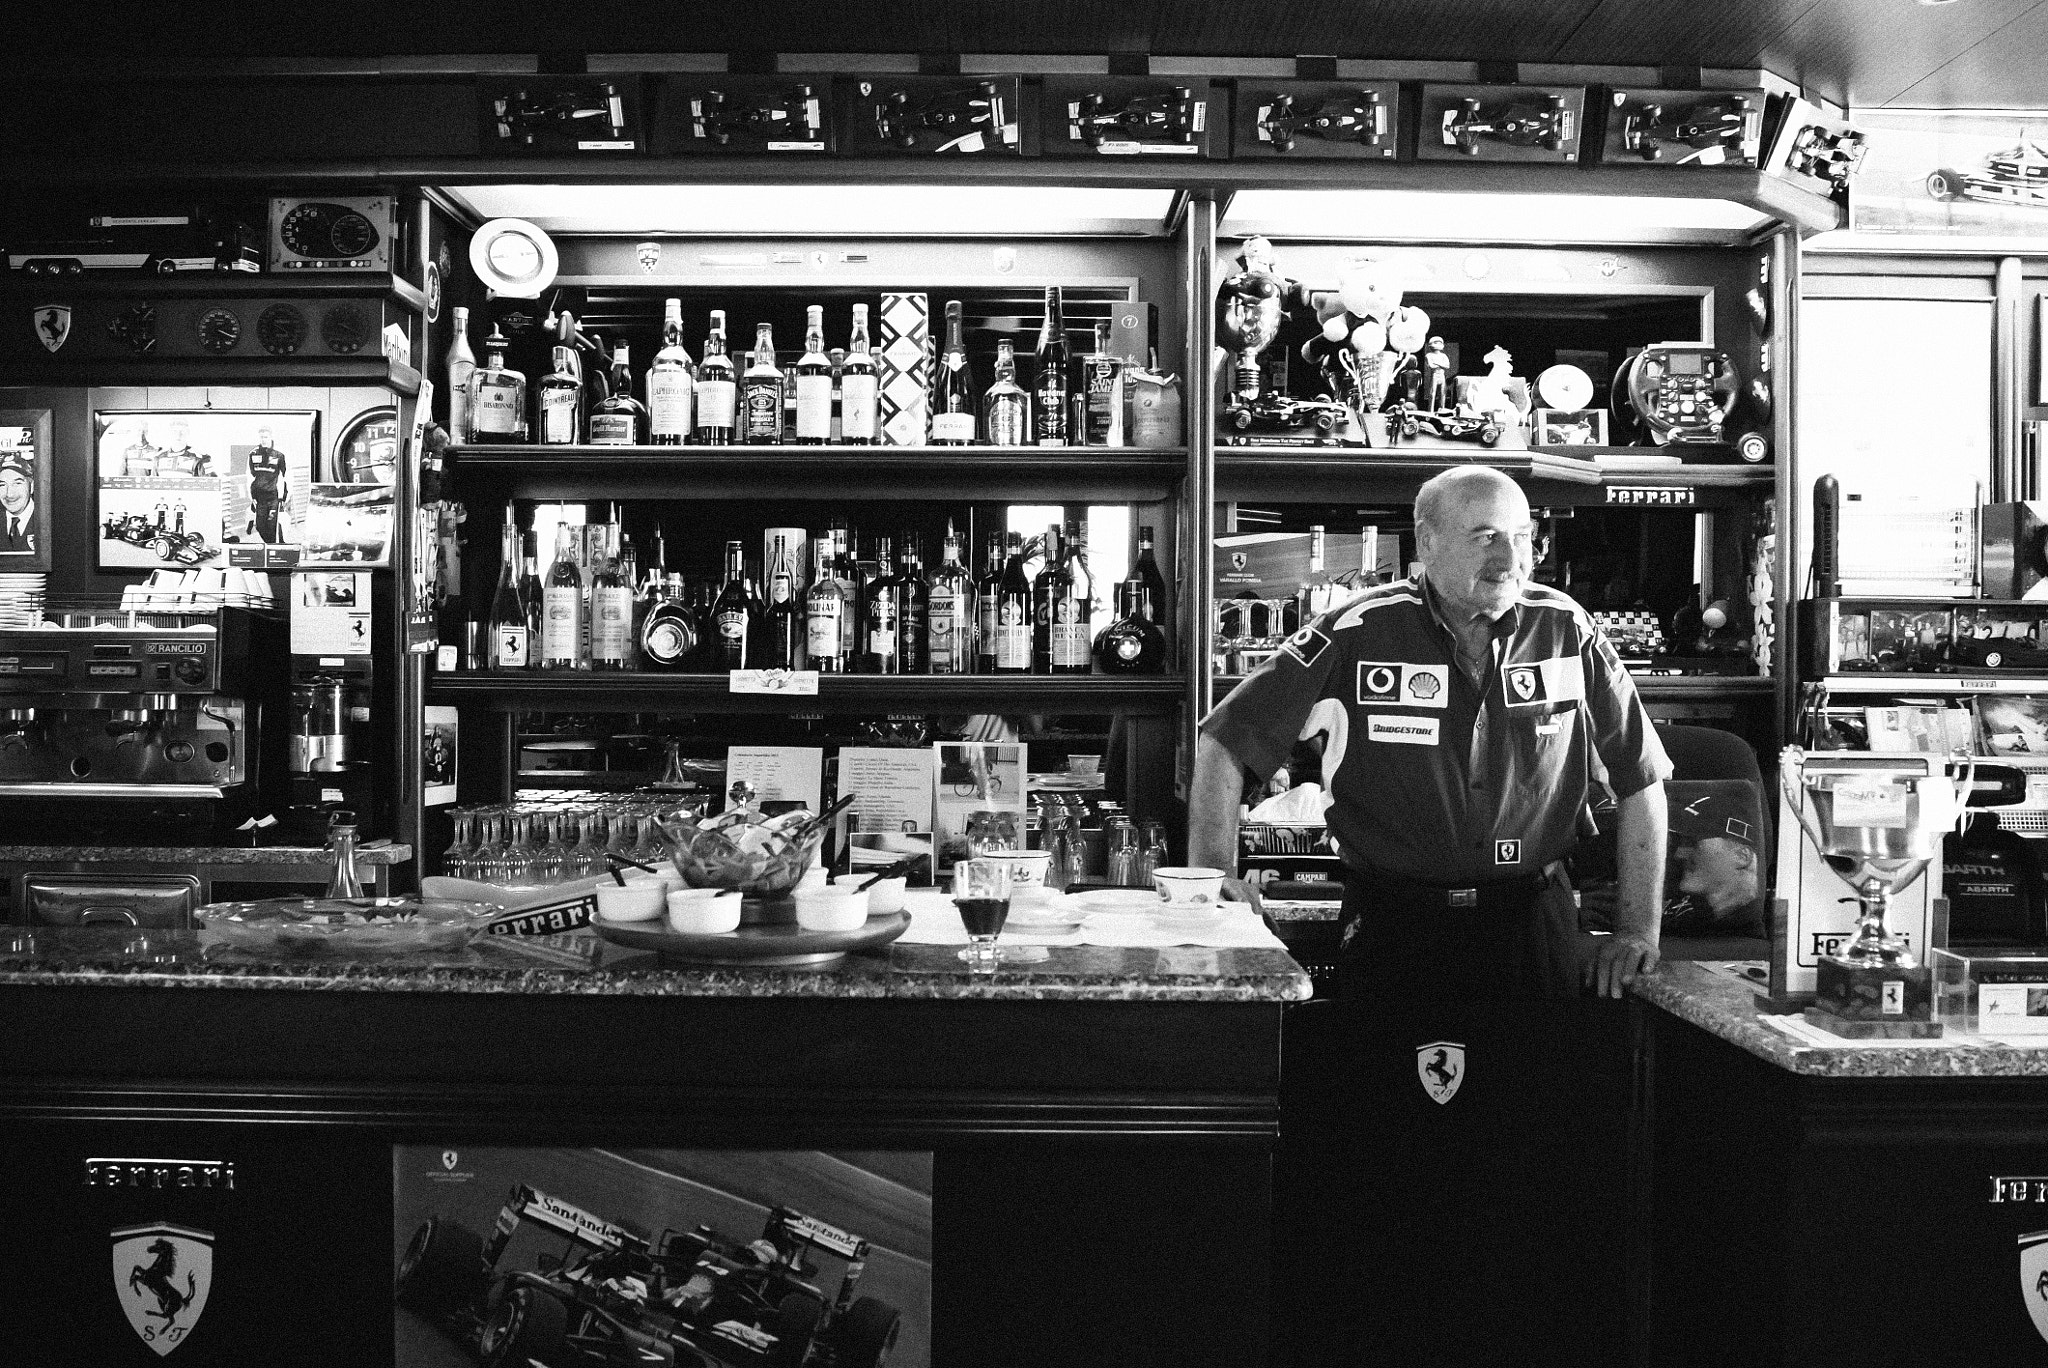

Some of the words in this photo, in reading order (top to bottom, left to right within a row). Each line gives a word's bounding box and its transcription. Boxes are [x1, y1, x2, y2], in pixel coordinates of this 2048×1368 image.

[483, 401, 514, 409] DISARONNO
[544, 393, 576, 407] COINTREAU
[366, 428, 379, 438] 11
[383, 425, 395, 434] 12
[353, 442, 366, 452] 10
[158, 644, 204, 653] RANCILIO
[1296, 872, 1327, 882] CAMPARI
[493, 898, 596, 938] errari
